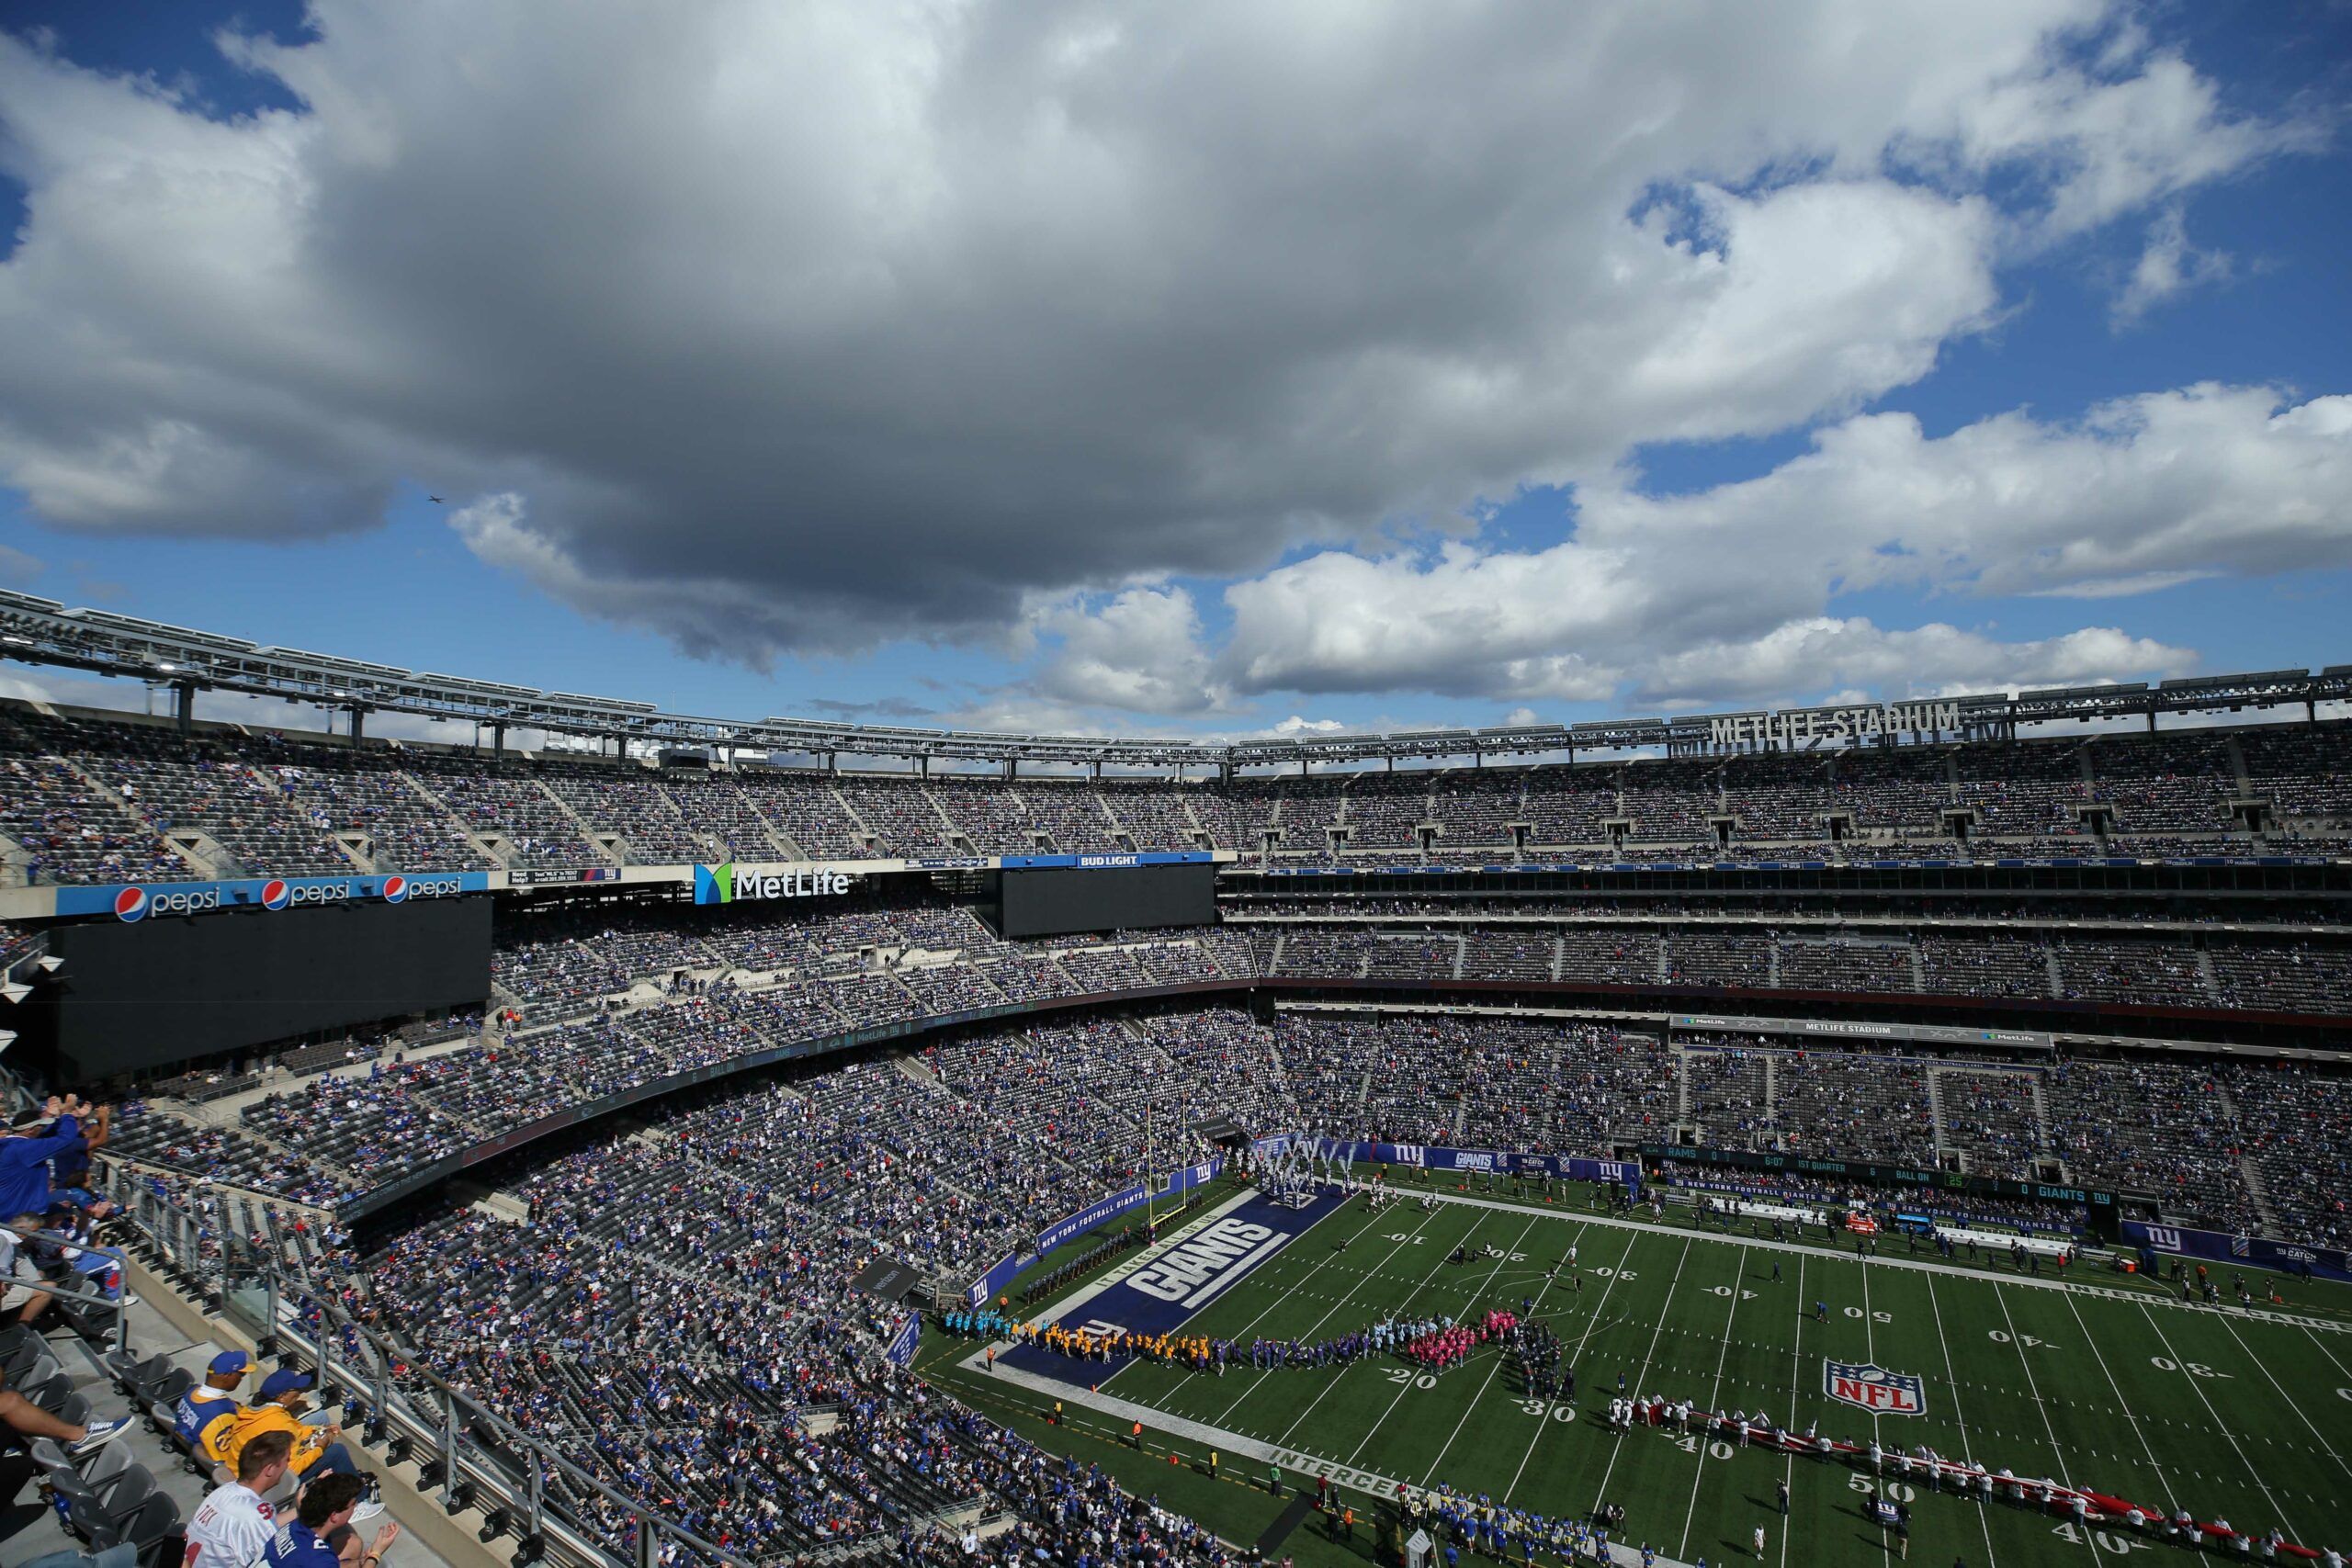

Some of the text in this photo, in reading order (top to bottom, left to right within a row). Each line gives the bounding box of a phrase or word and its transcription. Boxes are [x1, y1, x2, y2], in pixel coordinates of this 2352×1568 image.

[1711, 703, 1960, 744] METLIFE STADIUM
[1080, 855, 1137, 867] BUD LIGHT
[290, 880, 350, 905] pepsi
[408, 876, 460, 900] pepsi
[736, 867, 849, 900] MetLife
[152, 887, 220, 918] pepsi
[857, 1030, 887, 1043] MetLife
[1848, 1025, 1891, 1034] STADIUM
[1997, 1033, 2035, 1042] MetLife
[1394, 1145, 1424, 1167] ny
[1455, 1153, 1492, 1168] GIANTS
[1668, 1147, 1696, 1158] RAMS
[1712, 1152, 1717, 1160] 0
[1196, 1163, 1211, 1183] ny
[1599, 1162, 1623, 1180] ny
[1765, 1156, 1846, 1173] 6:07 1ST QUARTER
[1896, 1170, 1916, 1180] BALL
[1917, 1172, 1929, 1181] ON
[1950, 1176, 1962, 1186] 25
[1735, 1185, 1780, 1196] FOOTBALL
[1821, 1194, 1830, 1202] ny
[2022, 1185, 2110, 1204] 0 GIANTS ny
[1042, 1192, 1143, 1248] NEW YORK FOOTBALL GIANTS
[2059, 1224, 2070, 1233] ny
[2146, 1225, 2182, 1251] ny
[1094, 1214, 1218, 1287] IT TAKES ALL OF US
[1126, 1218, 1273, 1302] GIANTS
[2288, 1250, 2316, 1259] CATCH
[873, 1269, 900, 1291] verizon
[973, 1279, 989, 1308] ny
[1387, 1369, 1437, 1389] 20
[1835, 1378, 1914, 1410] NFL
[1522, 1399, 1576, 1423] 30
[1675, 1436, 1734, 1460] 40
[1849, 1472, 1916, 1503] 50
[1878, 1502, 1896, 1515] ny
[2052, 1522, 2130, 1554] 40
